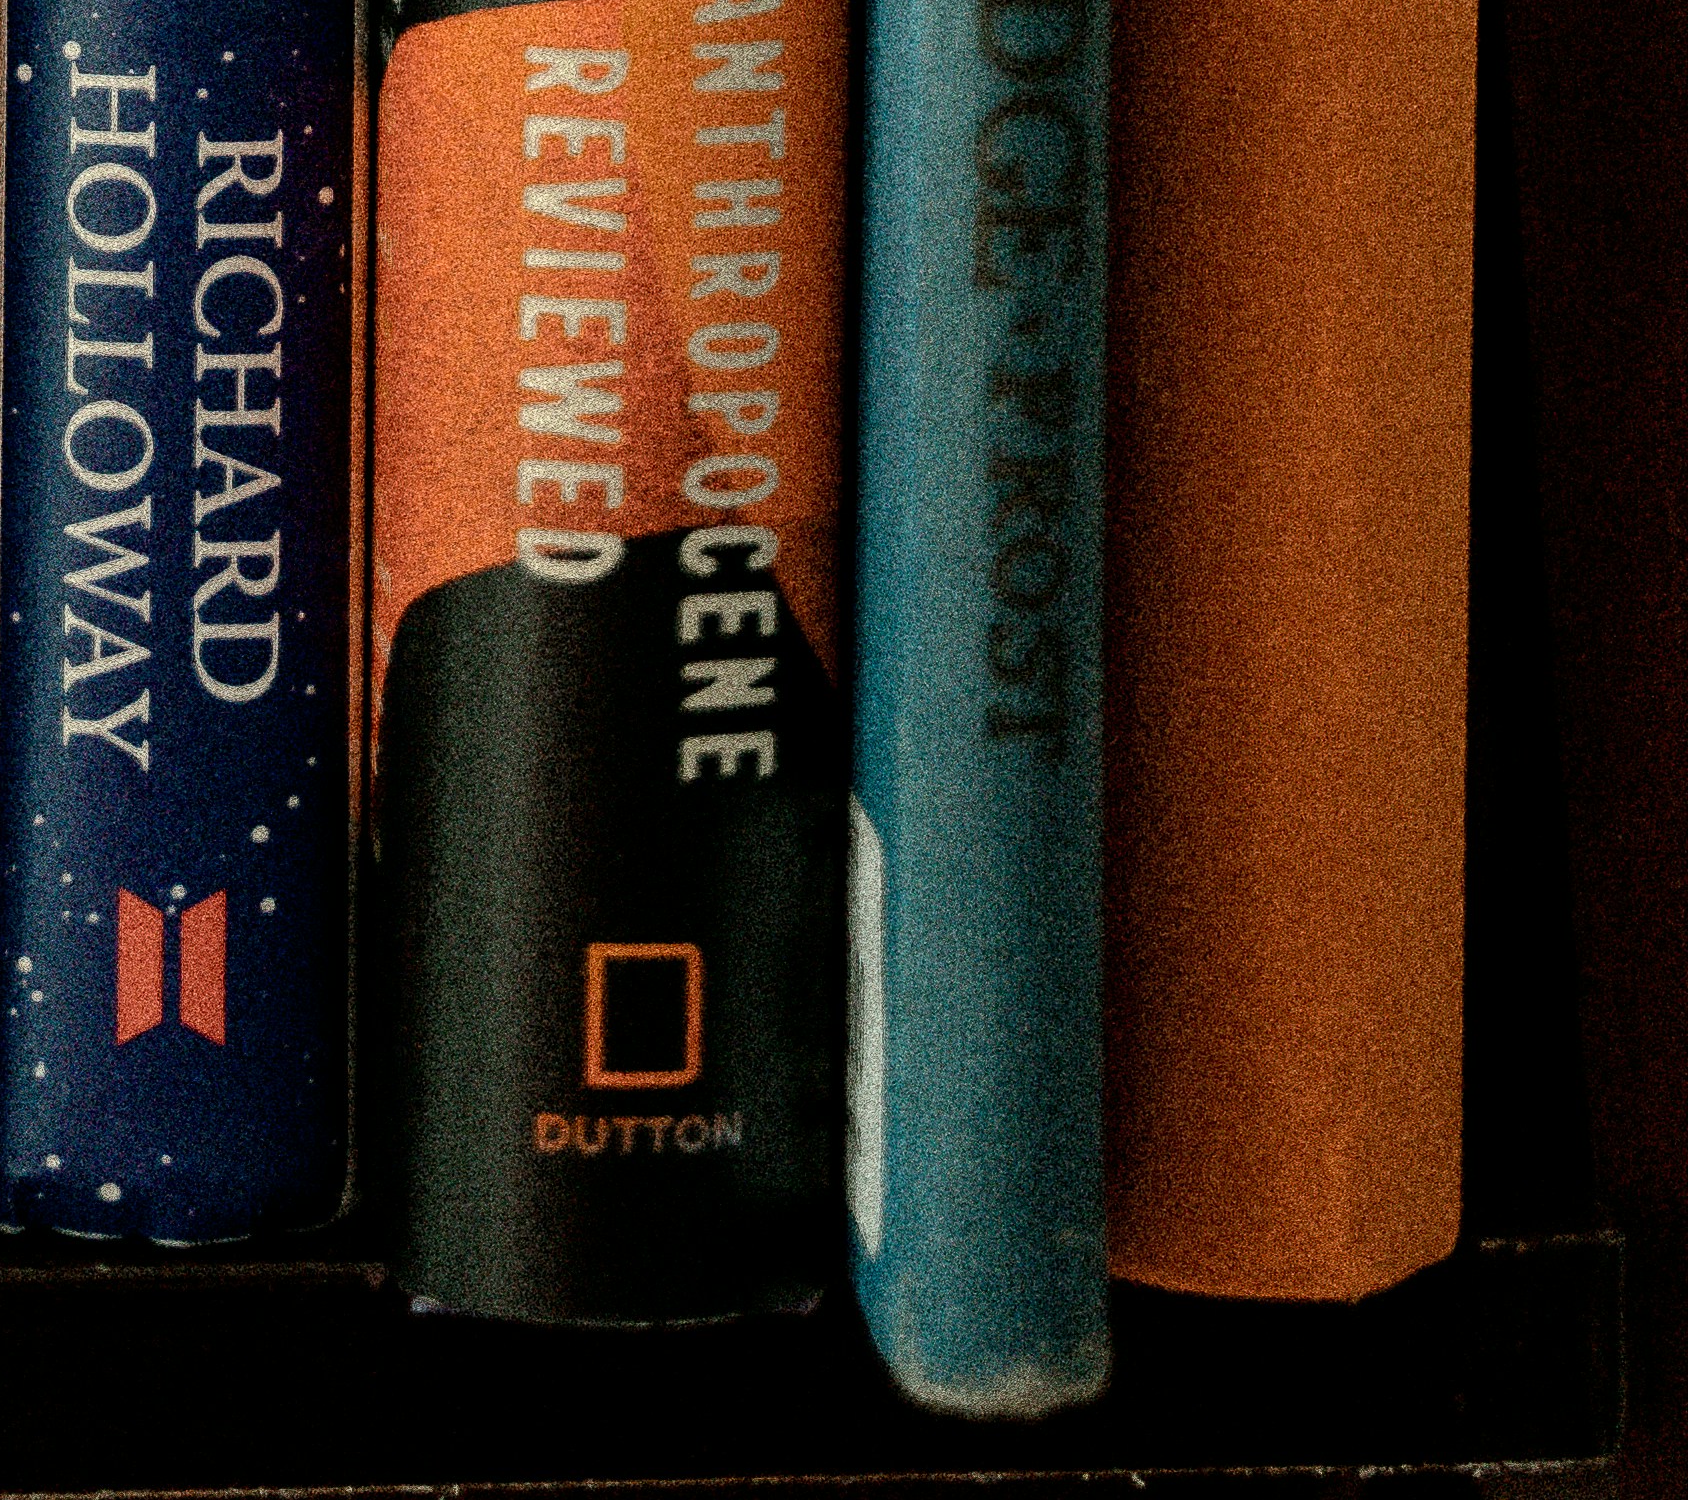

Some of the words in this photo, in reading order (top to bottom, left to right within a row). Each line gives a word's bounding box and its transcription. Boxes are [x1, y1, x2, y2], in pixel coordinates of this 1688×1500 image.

[60, 66, 158, 771] HOLLOWAY
[192, 130, 285, 705] RICHARD
[514, 45, 630, 584] REVIEWED
[533, 1110, 744, 1156] DUTTON
